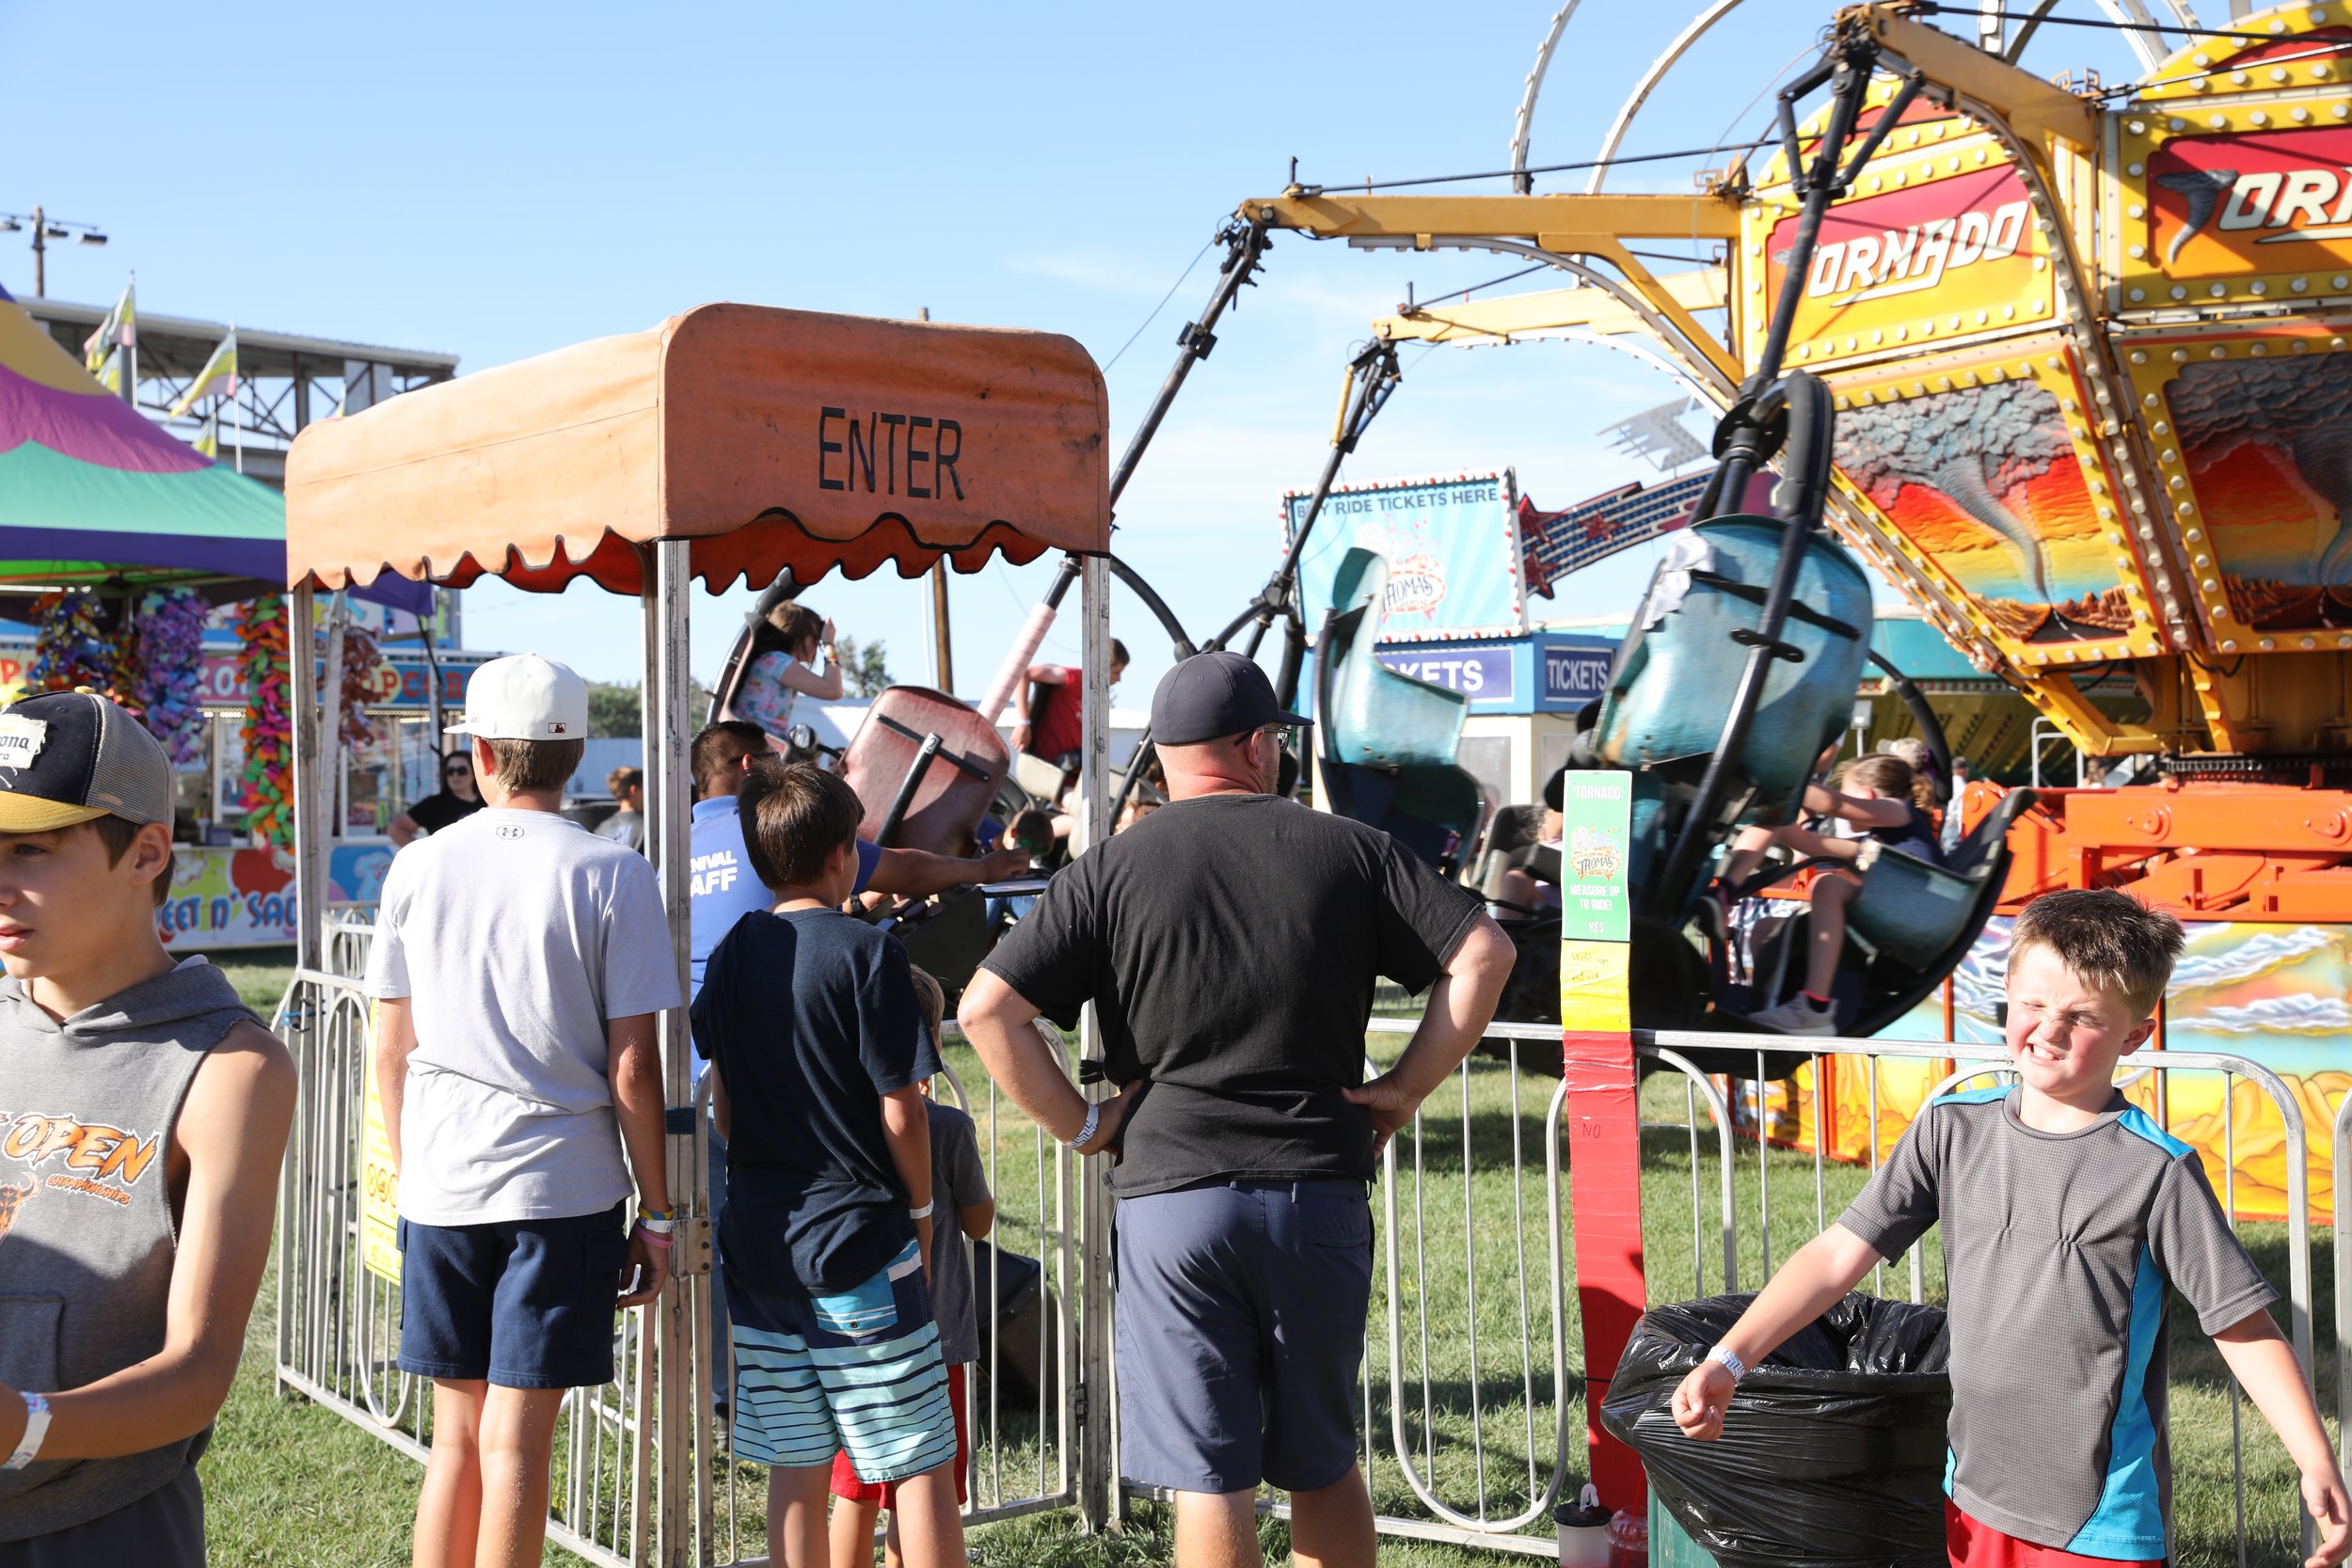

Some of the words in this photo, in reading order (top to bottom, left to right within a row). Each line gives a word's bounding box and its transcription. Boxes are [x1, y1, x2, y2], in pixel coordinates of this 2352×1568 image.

[819, 406, 964, 499] ENTER
[1296, 502, 1329, 518] BY
[1335, 499, 1374, 515] RIDE
[1377, 492, 1448, 511] TICKETS
[1452, 488, 1499, 505] HERE
[1547, 658, 1608, 690] TICKETS
[0, 736, 29, 750] ona
[925, 737, 938, 752] 2
[1575, 785, 1622, 800] TORNADO
[691, 850, 738, 873] NIVAL
[1577, 856, 1613, 875] THOMAS
[691, 867, 738, 897] AFF
[1569, 883, 1608, 896] MEASURE
[1609, 885, 1621, 897] UP
[156, 896, 201, 931] EET
[1579, 898, 1591, 910] TO
[1591, 898, 1613, 911] RIDE!
[1588, 921, 1605, 933] YES
[1581, 1123, 1601, 1139] NO
[4, 1114, 160, 1184] OPEN
